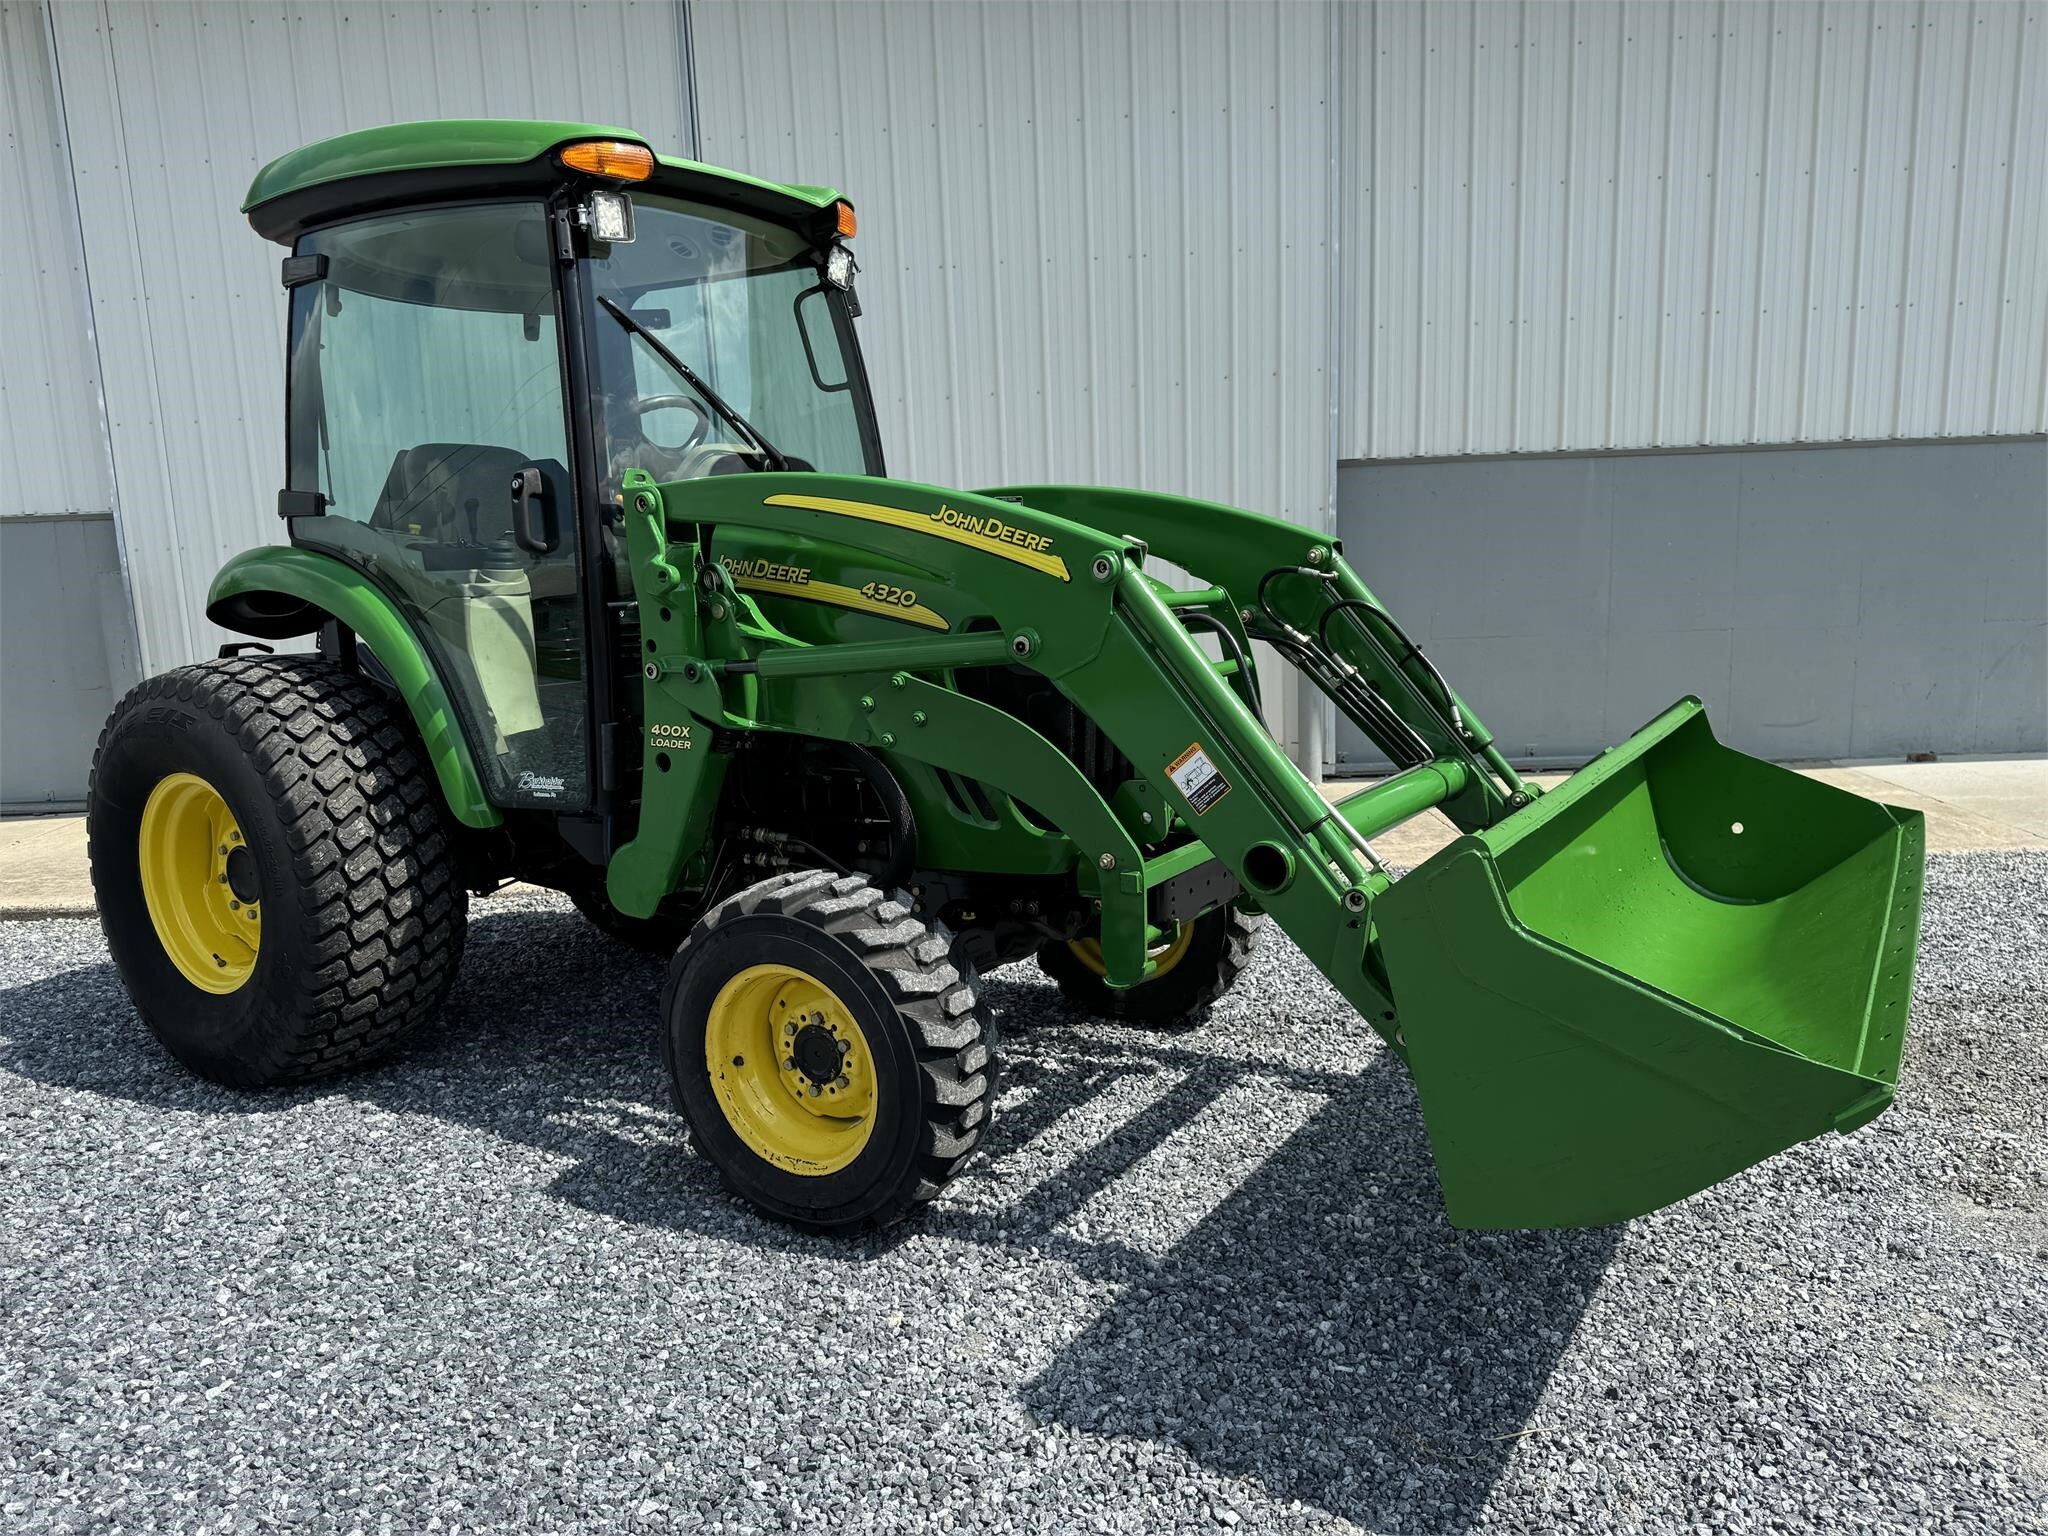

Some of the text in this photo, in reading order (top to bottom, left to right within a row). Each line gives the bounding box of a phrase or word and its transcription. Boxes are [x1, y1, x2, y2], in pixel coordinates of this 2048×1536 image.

[930, 504, 1054, 551] JOHN DEERE
[753, 559, 812, 584] DEERE
[861, 581, 917, 606] 4320
[651, 724, 690, 738] 400X
[650, 737, 692, 750] LOADER
[1174, 746, 1197, 767] WARNING
